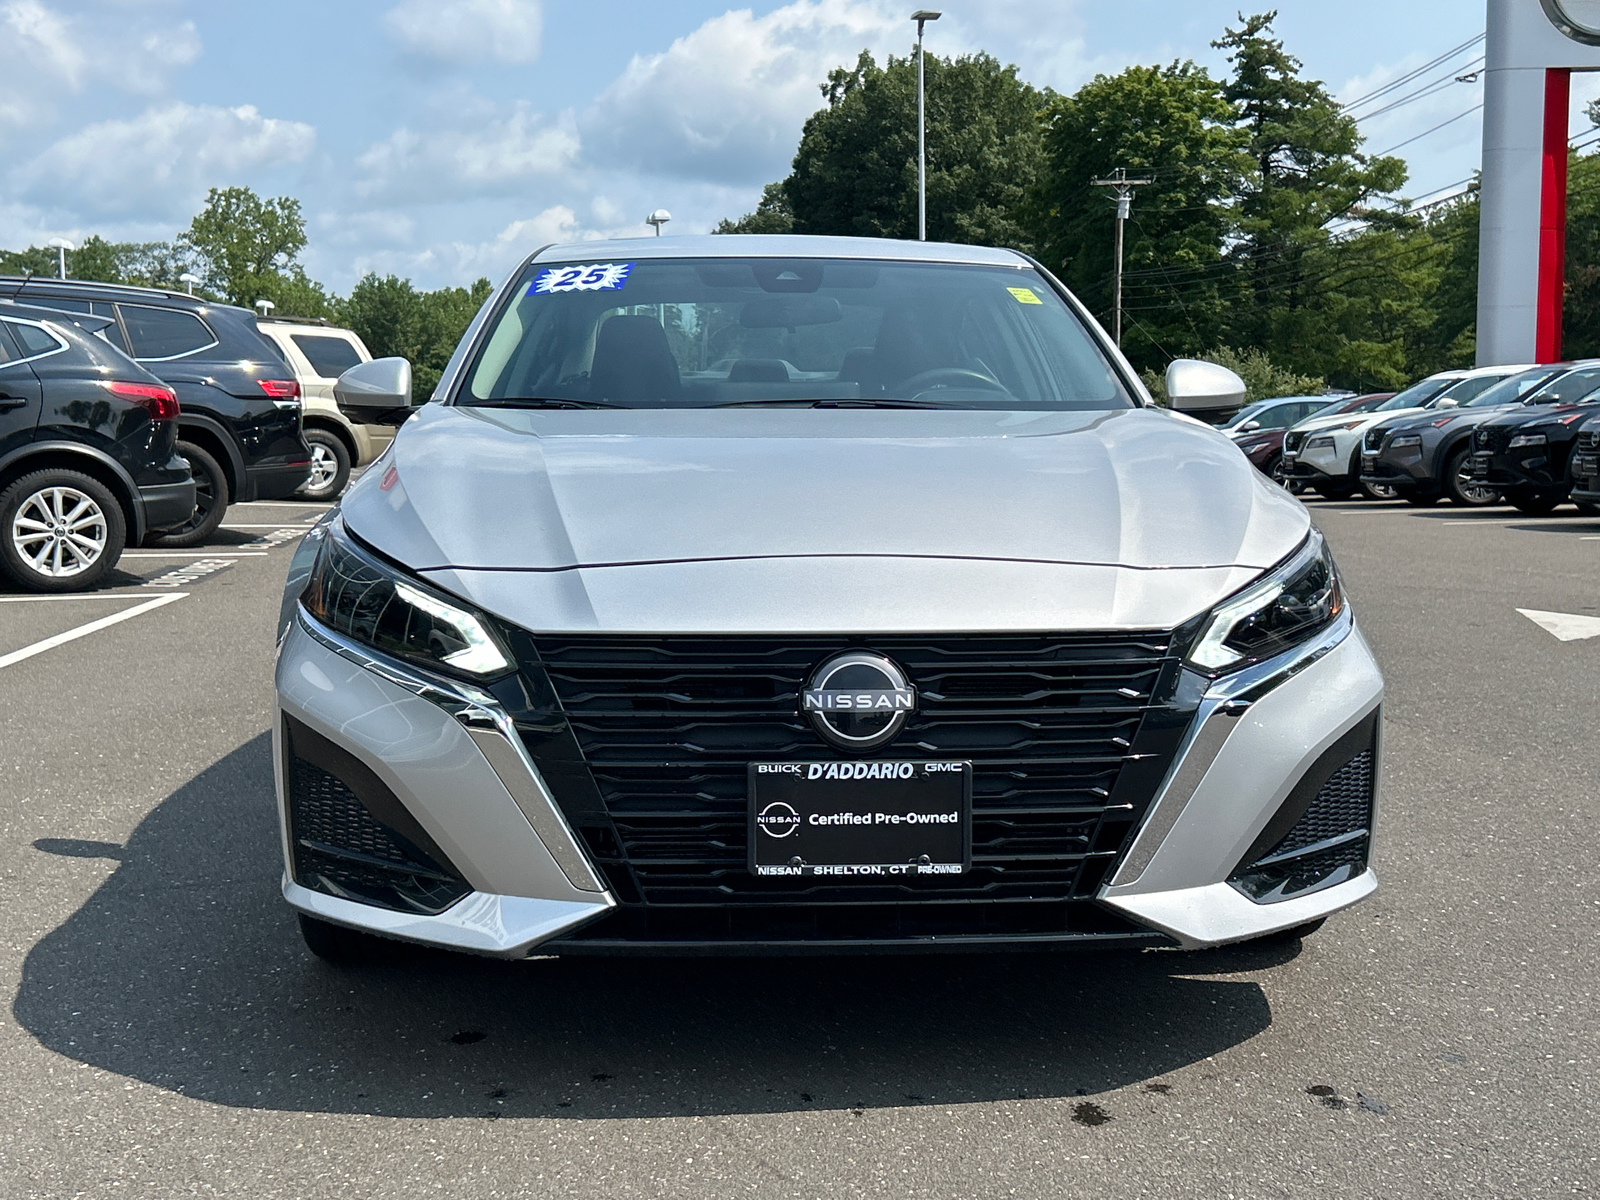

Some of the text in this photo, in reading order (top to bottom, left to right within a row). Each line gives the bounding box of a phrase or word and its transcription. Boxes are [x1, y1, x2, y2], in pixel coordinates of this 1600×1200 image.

[553, 268, 608, 287] 25
[805, 693, 912, 709] NISSAN
[758, 762, 963, 780] BUICK D'ADDARIO GMC
[757, 816, 801, 824] NISSAN
[808, 811, 958, 825] Certified Pre-Owned
[757, 865, 962, 875] NISSAN SHELTON, CT PRE-OWNED
